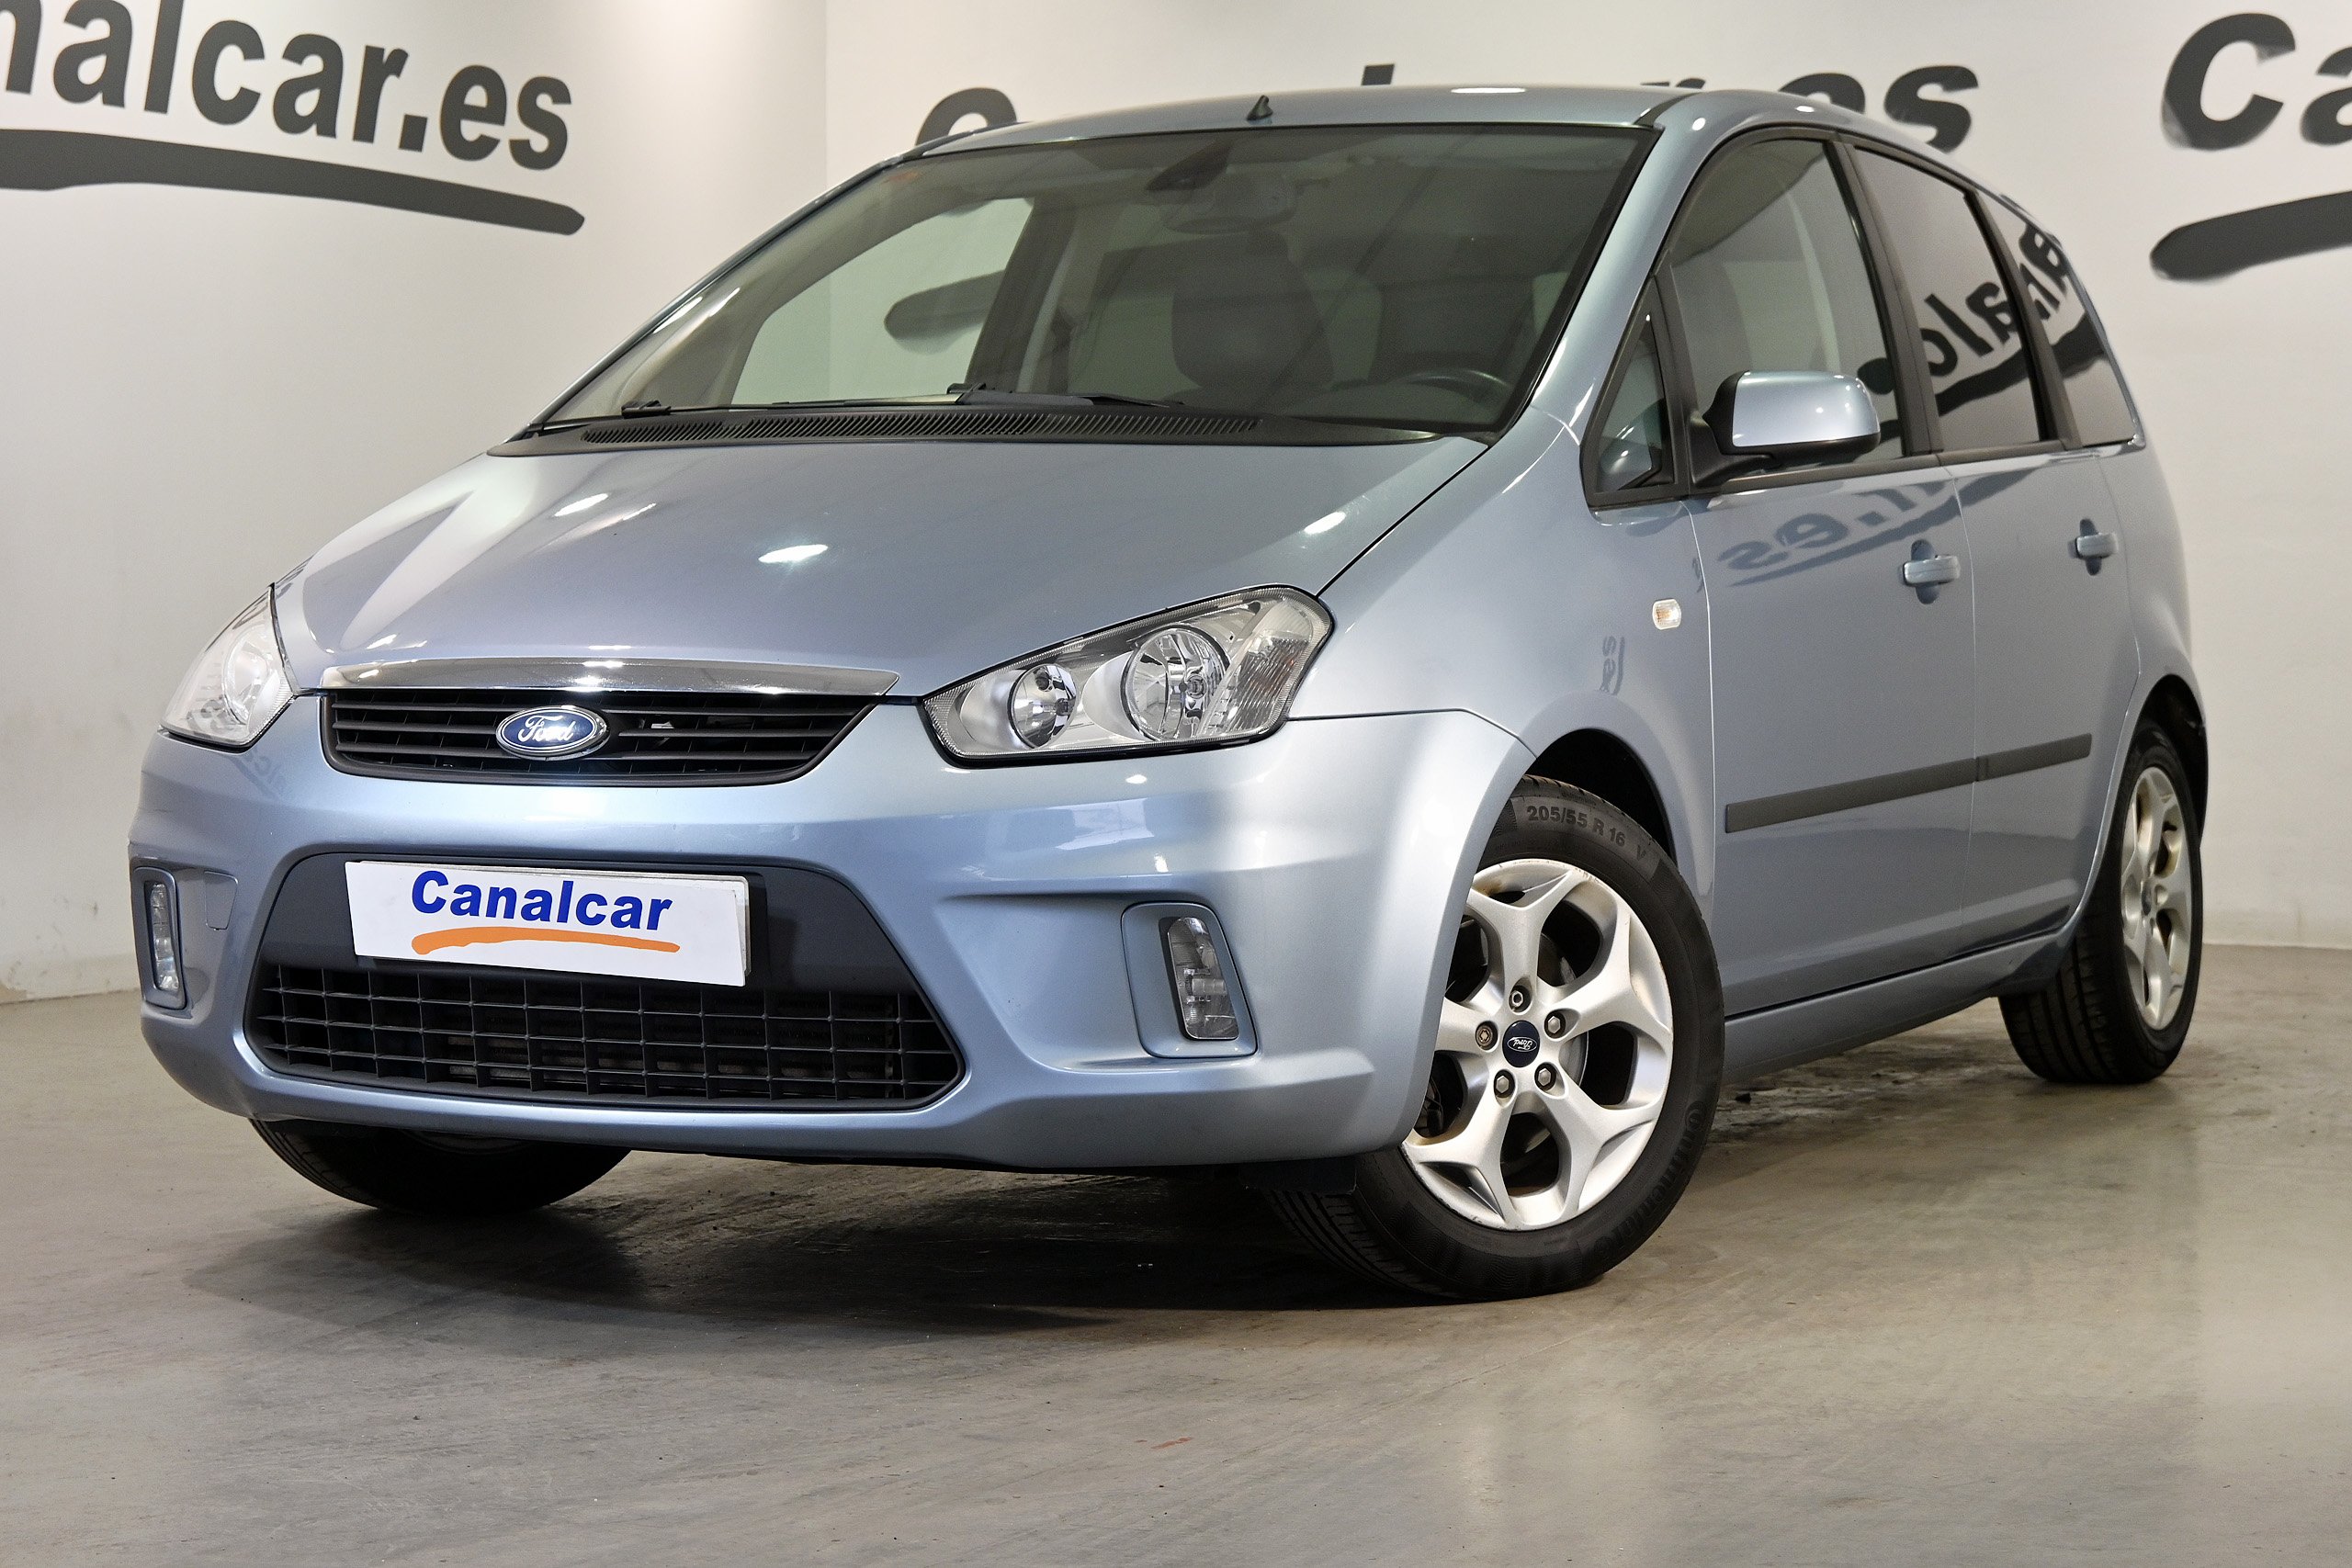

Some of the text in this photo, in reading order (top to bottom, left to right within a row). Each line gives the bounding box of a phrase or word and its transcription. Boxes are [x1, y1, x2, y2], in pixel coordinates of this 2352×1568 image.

[517, 715, 577, 742] Ford
[1527, 805, 1588, 829] 205/55
[1592, 818, 1605, 837] R
[1610, 828, 1626, 847] 16
[412, 870, 673, 931] Canalcar
